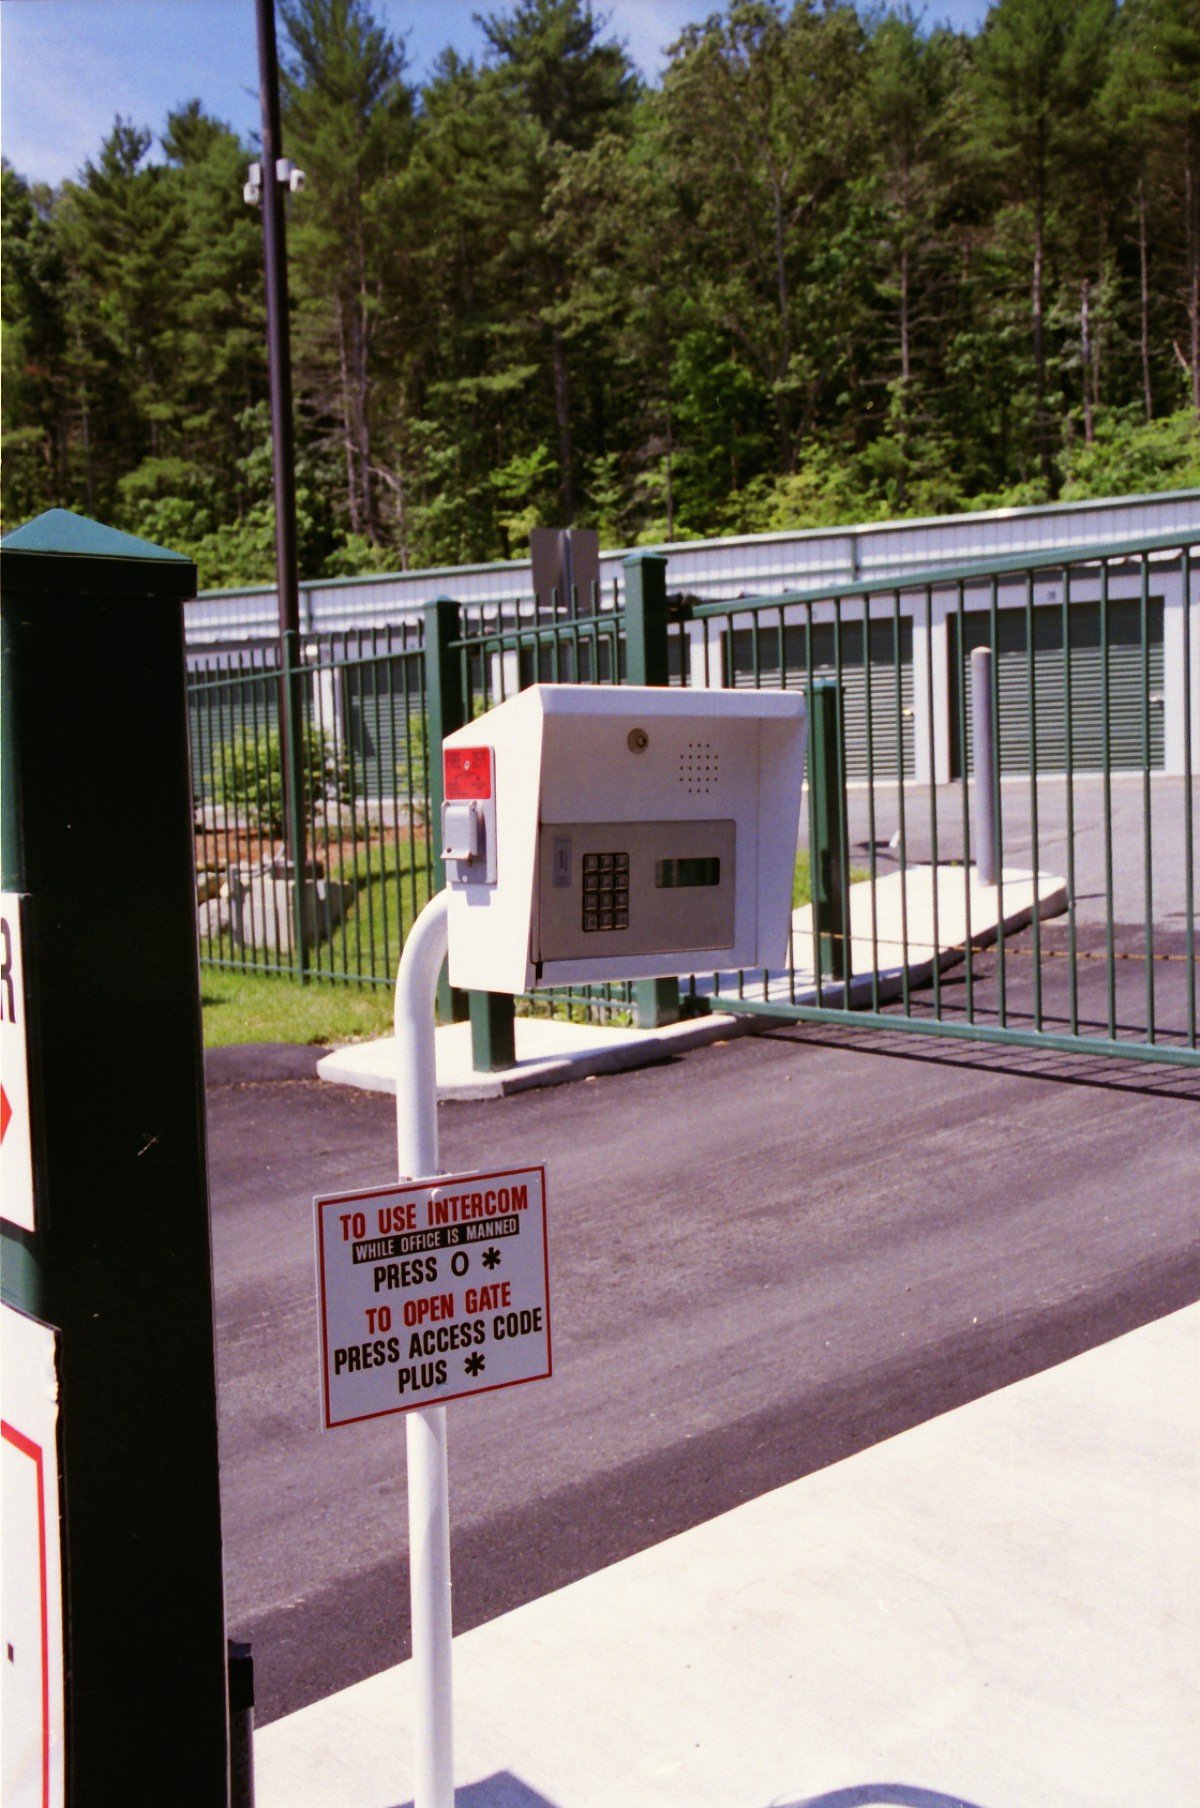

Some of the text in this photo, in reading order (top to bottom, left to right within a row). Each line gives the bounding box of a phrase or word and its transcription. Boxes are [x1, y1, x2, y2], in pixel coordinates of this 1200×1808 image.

[339, 1185, 528, 1241] TO USE INTERCOM
[355, 1216, 518, 1260] WHILE OFFICE IS MANNED
[374, 1256, 438, 1293] PRESS
[365, 1281, 512, 1335] TO OPEN GATE
[334, 1306, 543, 1376] PRESS ACCESS CODE
[398, 1359, 448, 1394] PLUS
